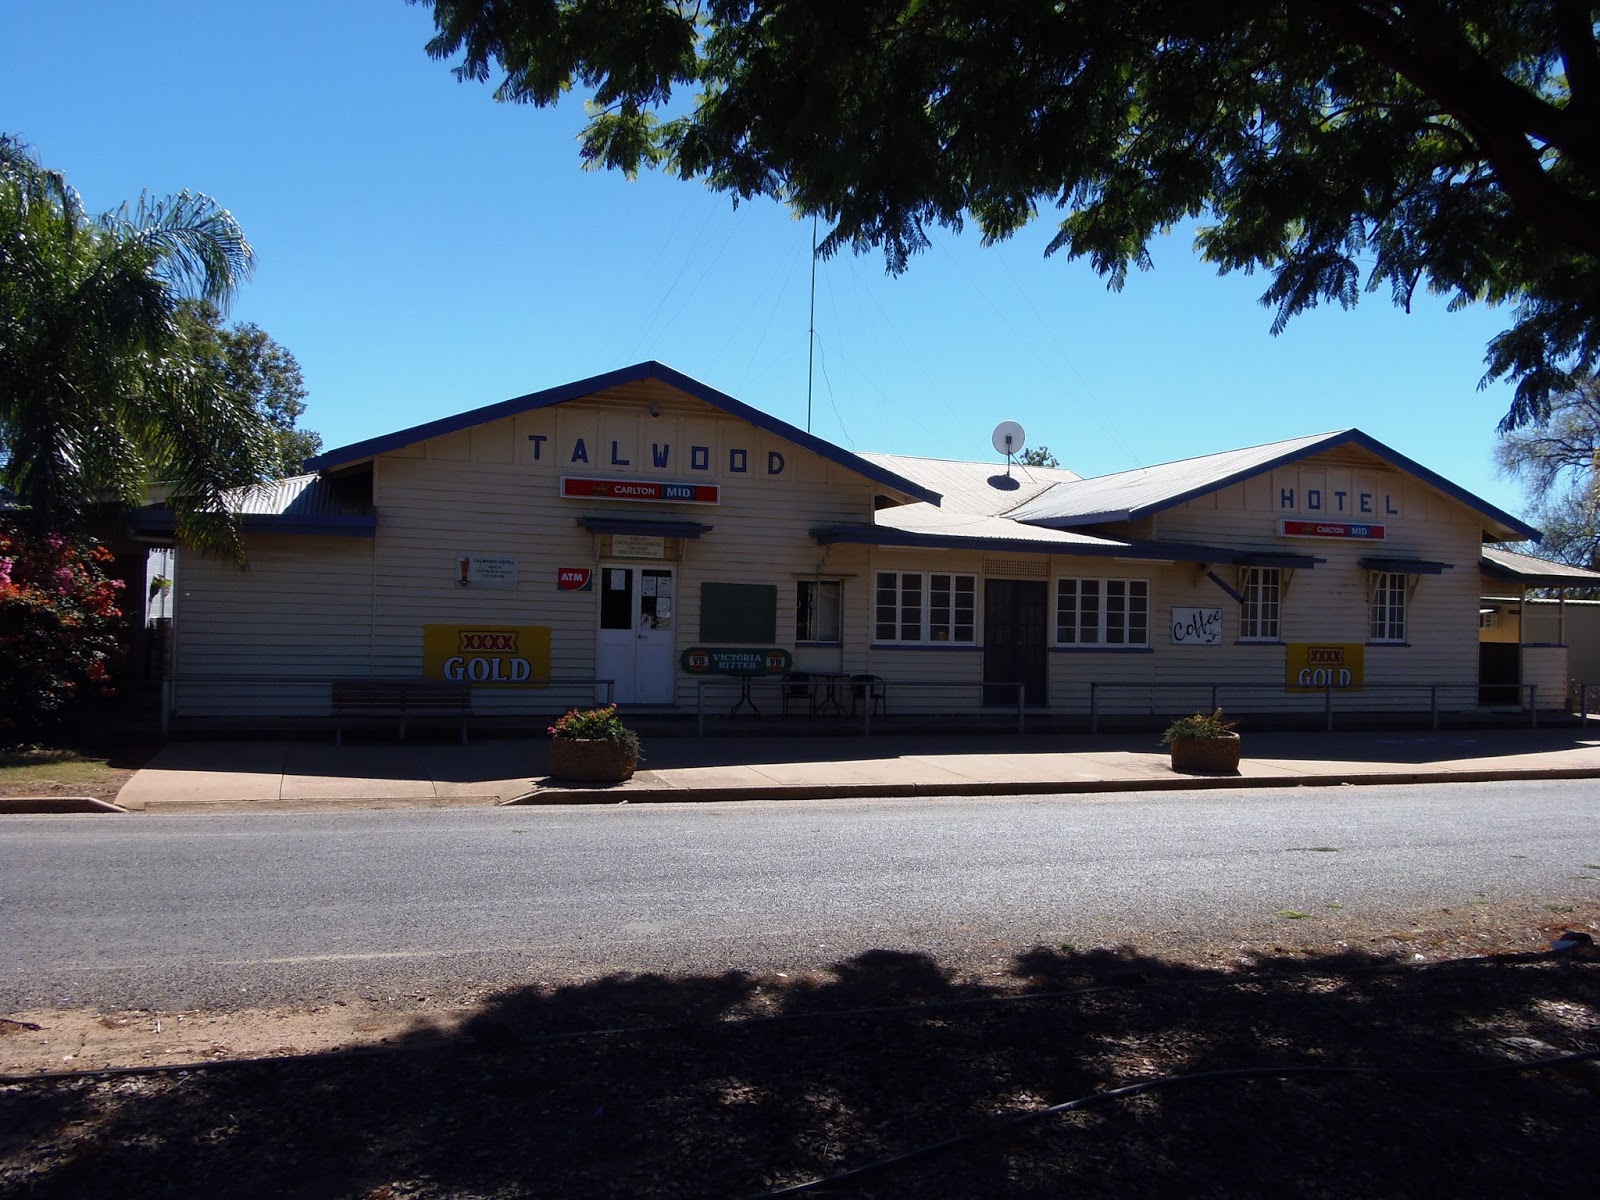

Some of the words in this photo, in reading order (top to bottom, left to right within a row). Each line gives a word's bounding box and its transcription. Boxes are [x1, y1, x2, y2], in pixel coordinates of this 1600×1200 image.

[528, 434, 785, 475] TALWOOD
[614, 485, 655, 496] CARLTON
[666, 487, 691, 498] MID
[1281, 488, 1398, 515] HOTEL
[1316, 525, 1344, 534] CARLTON
[1351, 527, 1368, 536] MID
[561, 572, 583, 582] ATM
[1173, 610, 1221, 641] Coffee
[463, 634, 514, 650] XXXX
[692, 656, 706, 666] VB
[712, 654, 762, 662] VICTORIA
[769, 657, 783, 667] VB
[1310, 650, 1342, 662] XXXX
[443, 656, 531, 681] GOLD
[719, 661, 757, 669] BITTER
[1298, 668, 1352, 688] GOLD
